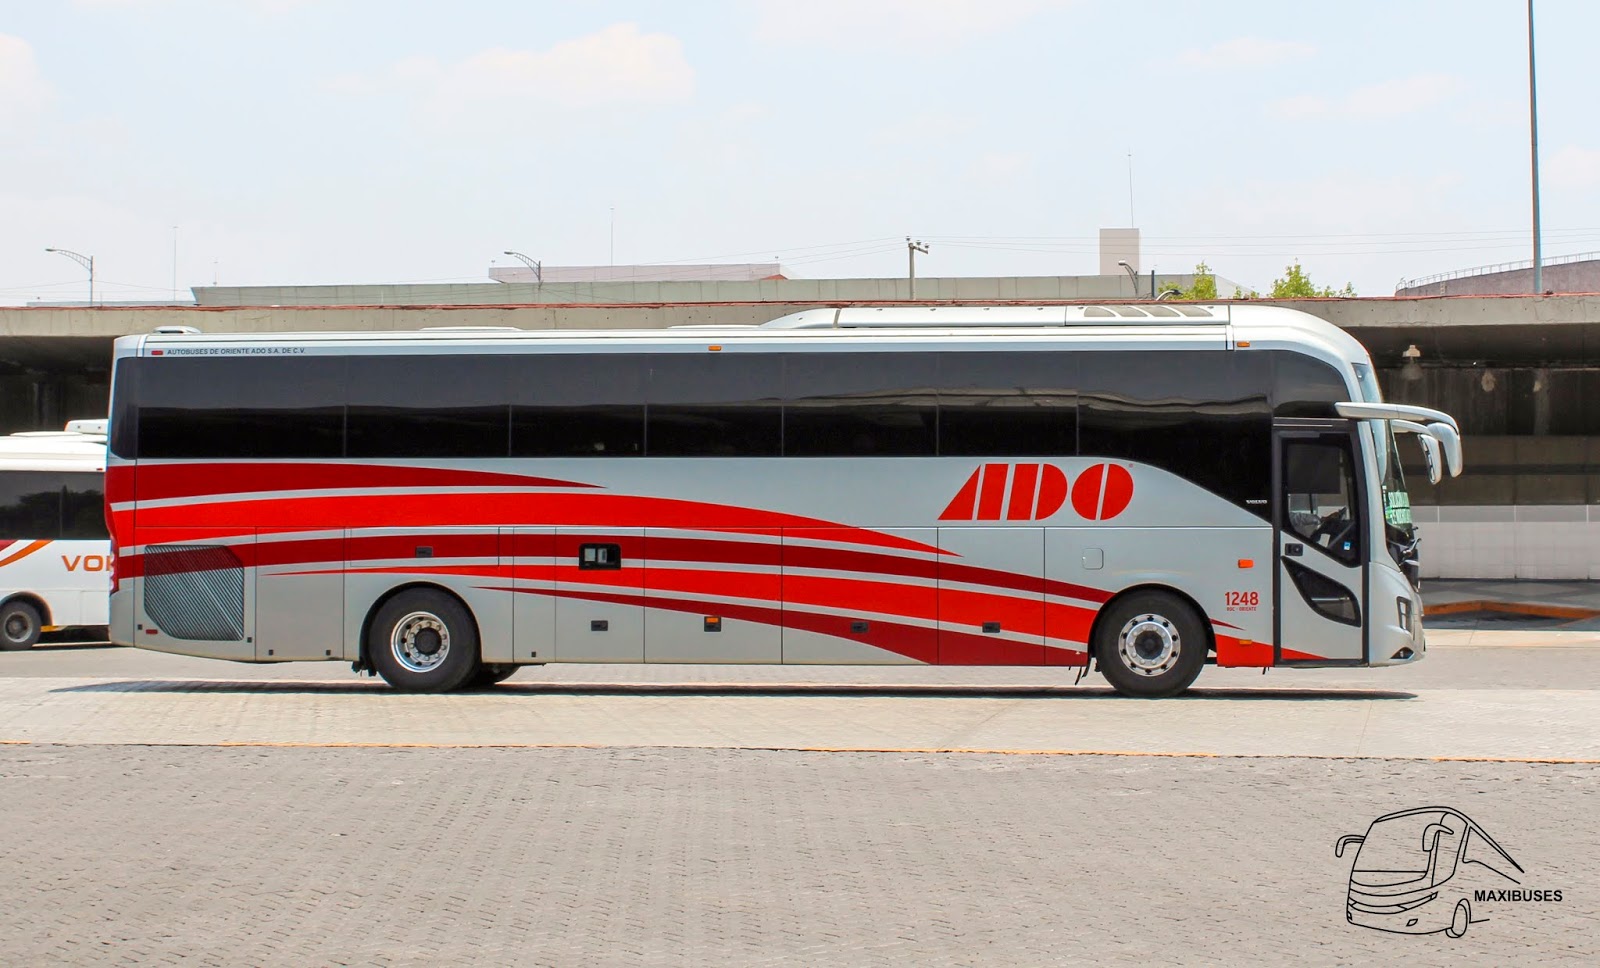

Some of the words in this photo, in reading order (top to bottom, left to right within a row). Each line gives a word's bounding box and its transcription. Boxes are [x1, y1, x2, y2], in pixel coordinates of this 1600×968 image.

[937, 463, 1134, 520] ADO
[61, 555, 111, 572] VO
[1225, 591, 1259, 606] 1248
